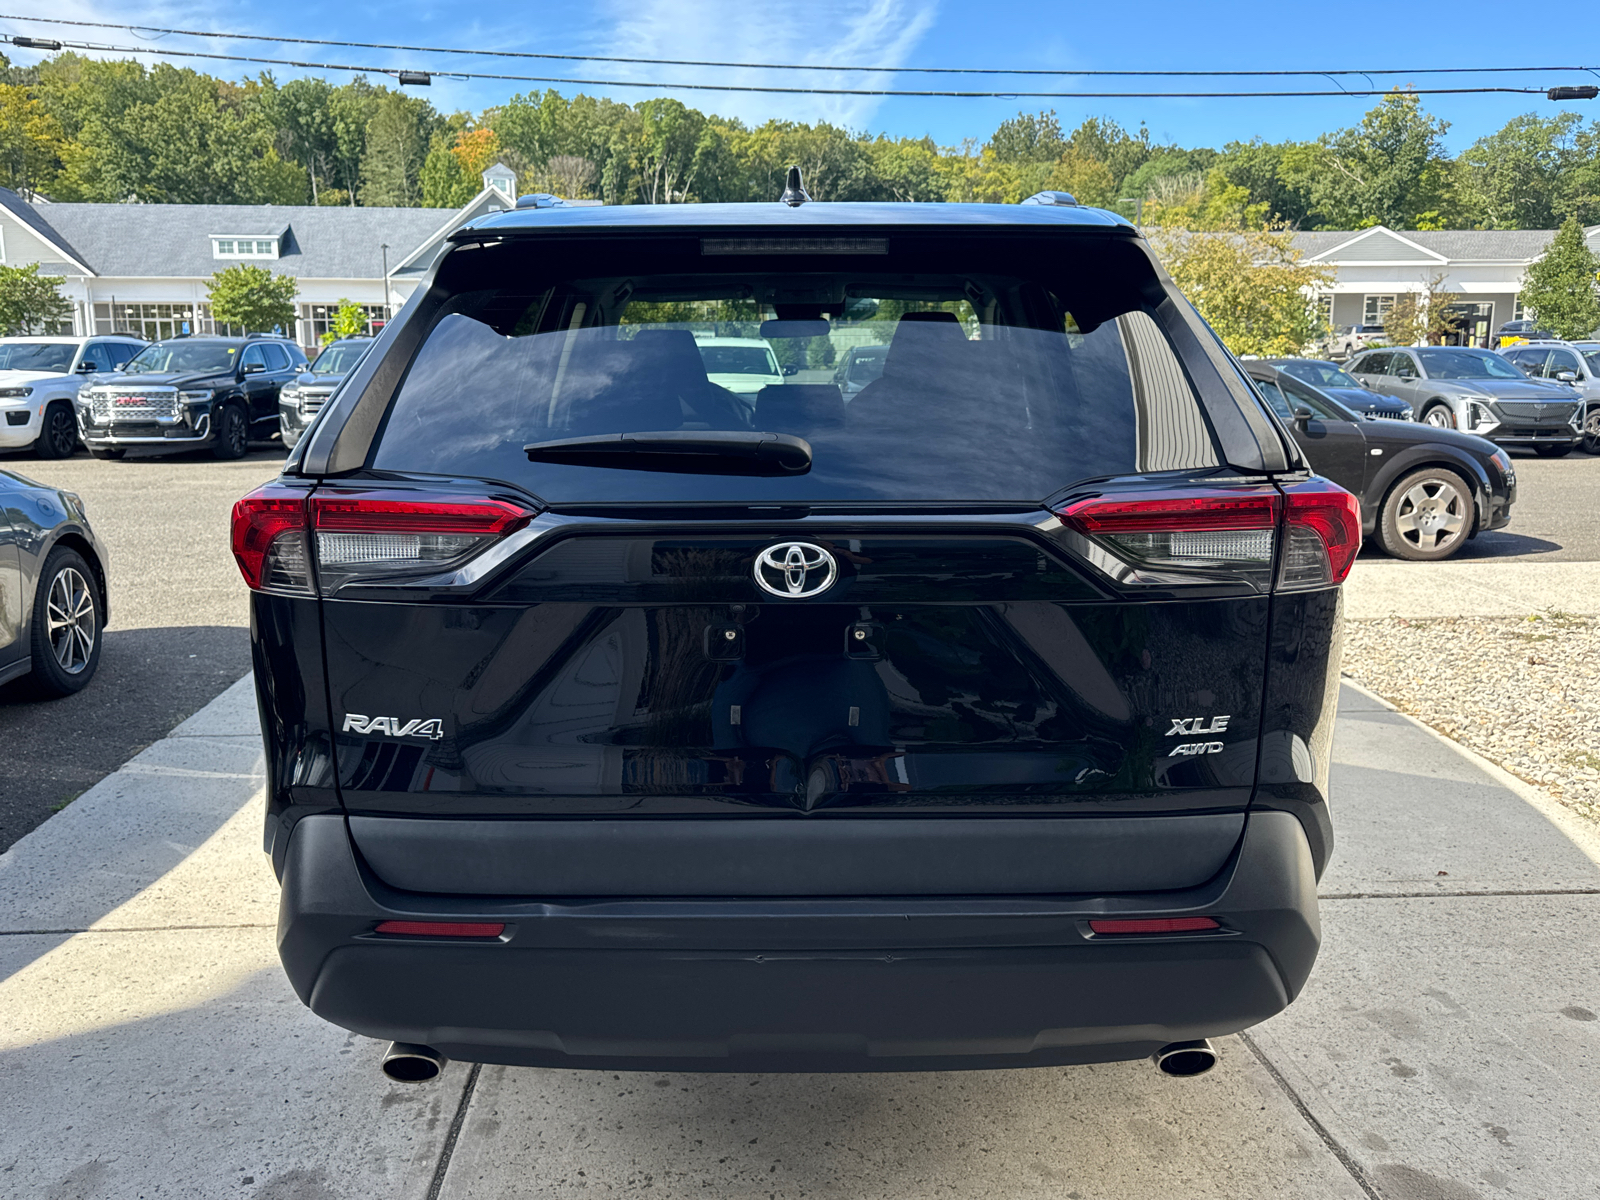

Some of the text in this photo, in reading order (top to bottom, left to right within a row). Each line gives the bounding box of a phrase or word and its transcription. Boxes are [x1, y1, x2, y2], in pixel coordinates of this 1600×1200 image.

[342, 713, 444, 740] RAV4
[1164, 715, 1231, 736] XLE
[1168, 741, 1224, 757] AWD
